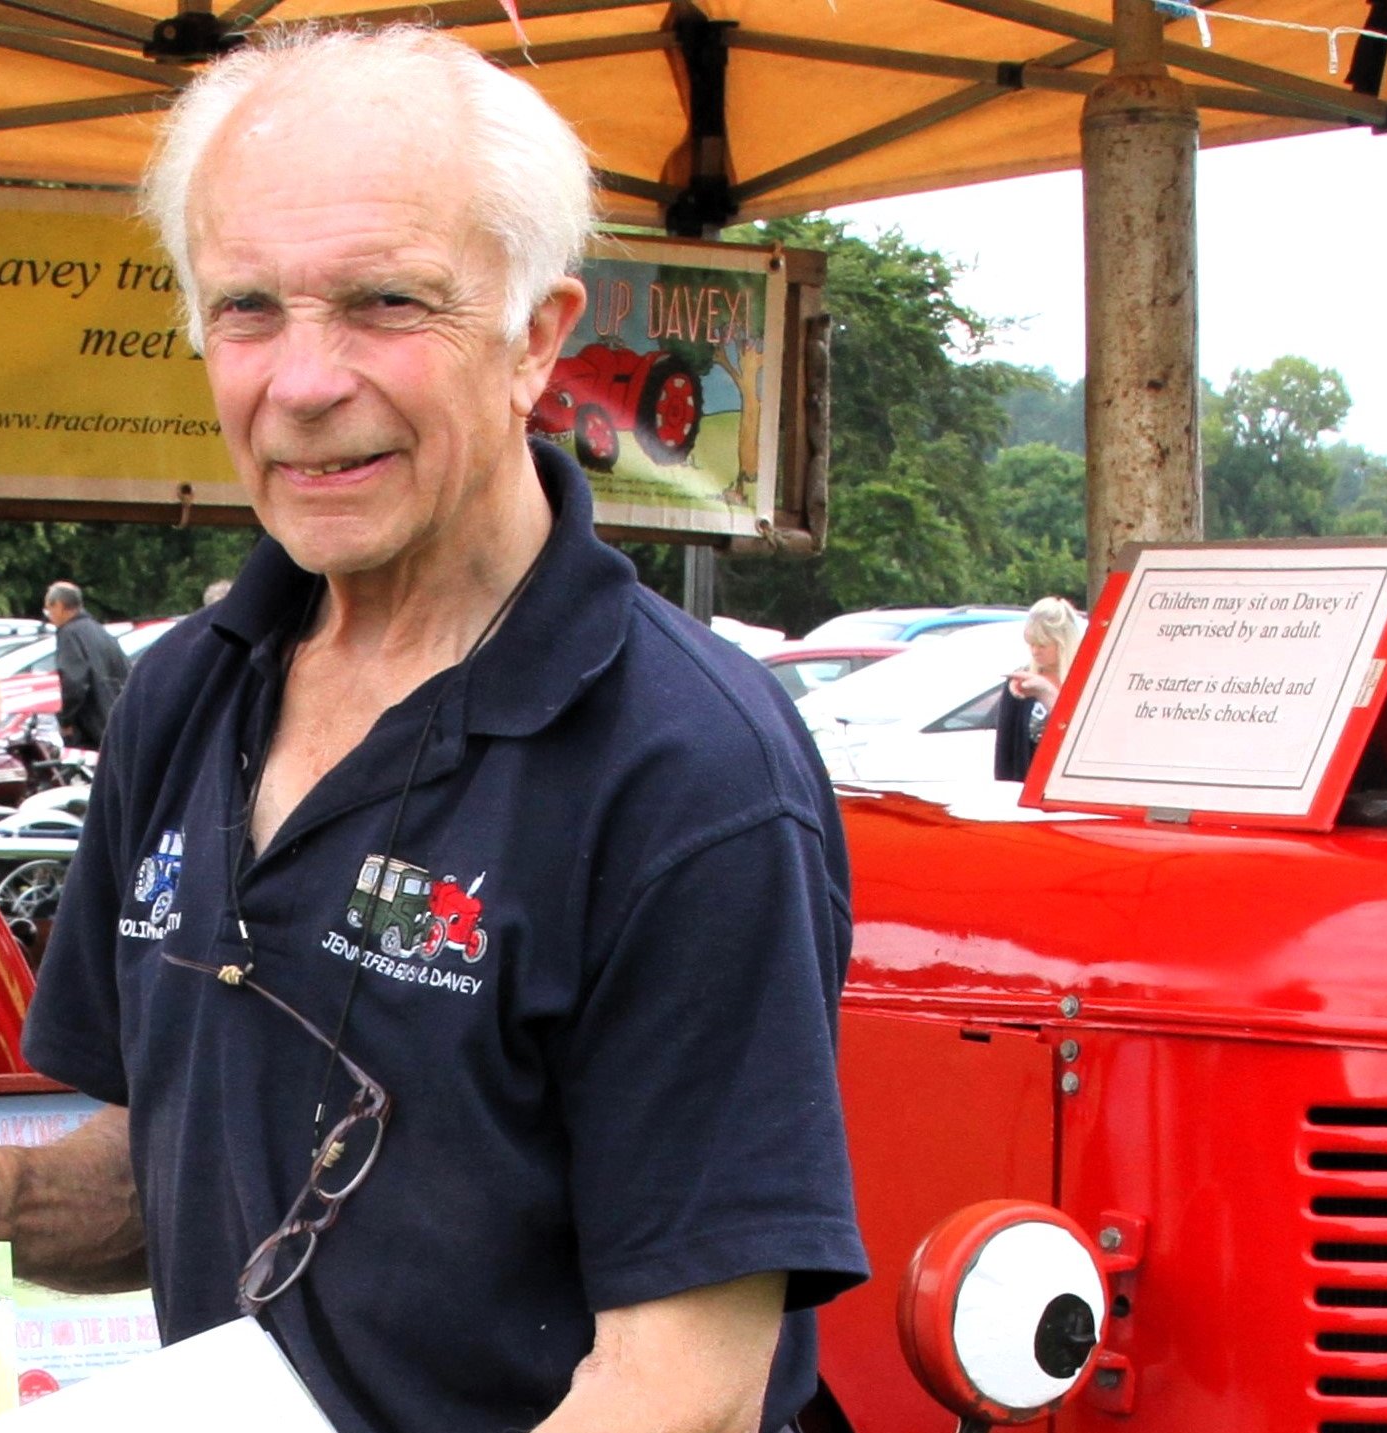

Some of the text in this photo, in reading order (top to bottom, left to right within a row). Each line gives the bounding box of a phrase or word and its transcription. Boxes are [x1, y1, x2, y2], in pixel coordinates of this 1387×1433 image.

[594, 279, 754, 343] UP DAVEY!
[79, 327, 178, 360] meet
[1148, 590, 1363, 616] Children may sit on Davey if
[1157, 621, 1323, 641] supervised by an adult.
[1126, 673, 1316, 696] The starter is disabled and
[1135, 702, 1279, 724] the wheels chocked.
[321, 931, 395, 978] JENNIFER
[417, 966, 429, 984] &
[428, 967, 483, 995] DAVEY
